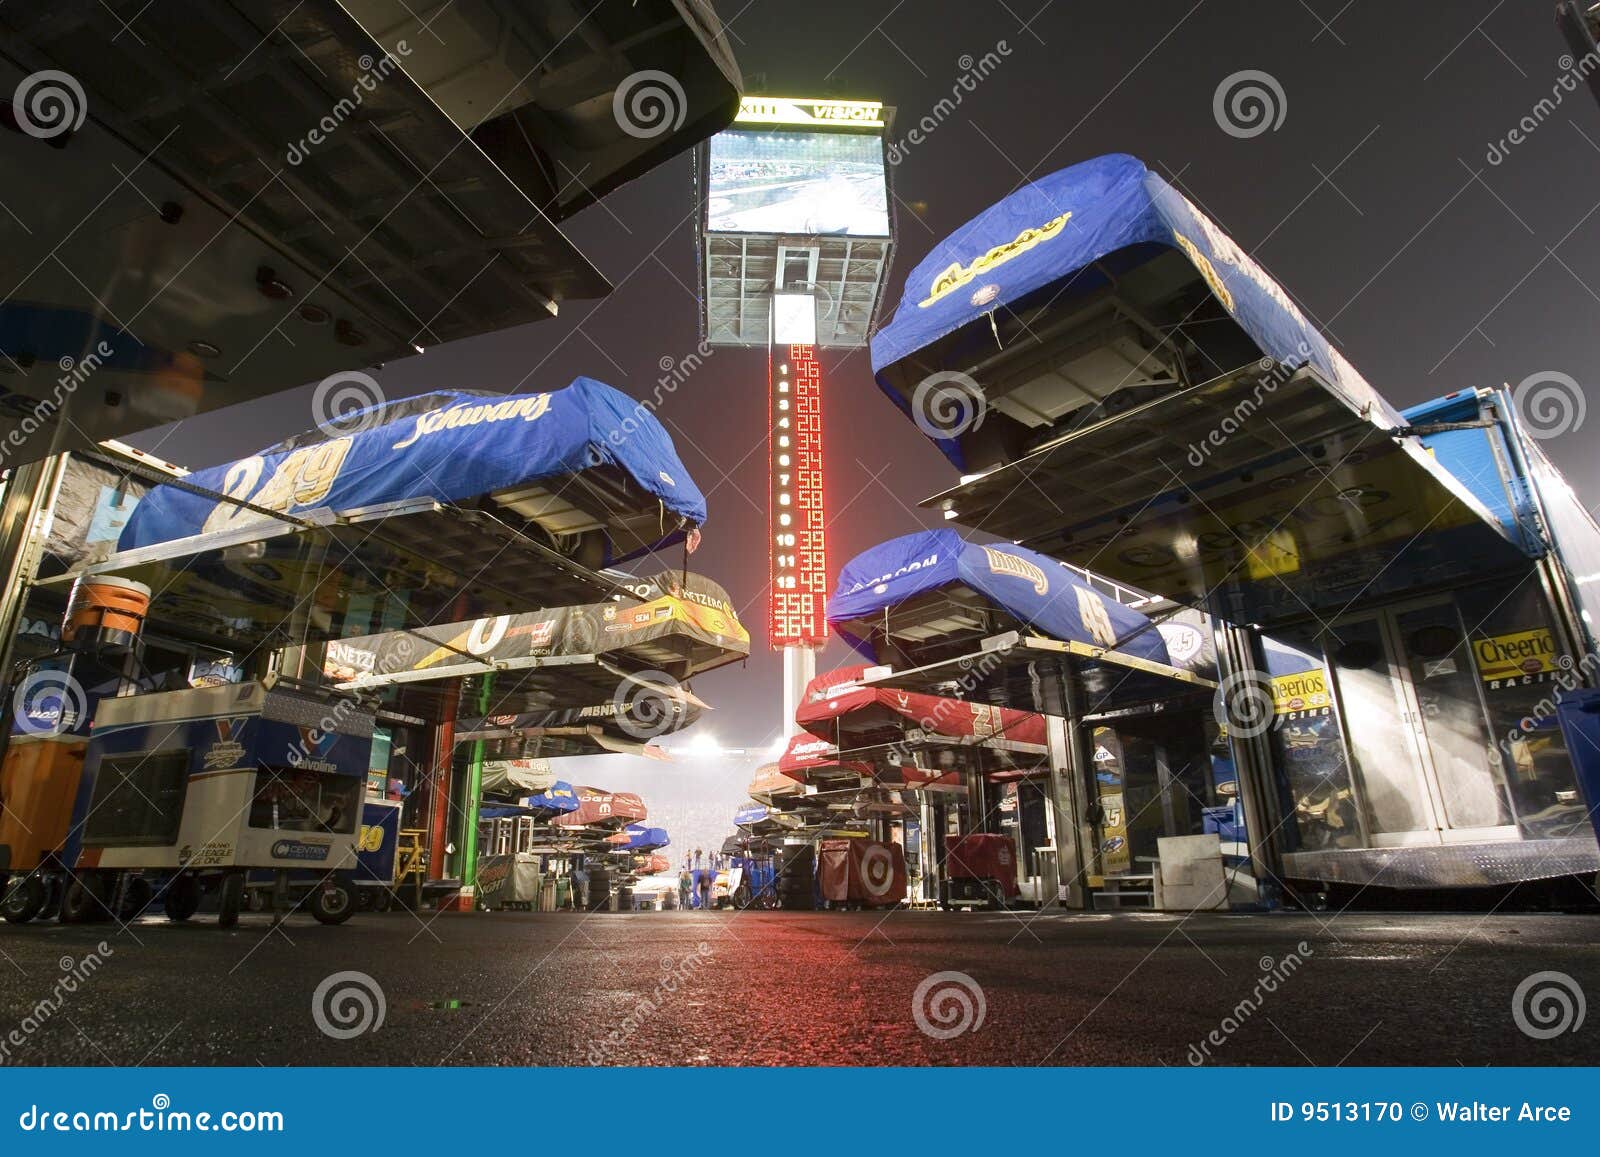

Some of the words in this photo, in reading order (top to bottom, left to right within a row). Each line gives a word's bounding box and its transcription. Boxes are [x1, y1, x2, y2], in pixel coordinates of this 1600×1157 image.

[814, 105, 879, 120] VISION
[779, 364, 788, 375] 1
[796, 361, 819, 377] 46
[797, 378, 820, 395] 64
[778, 399, 789, 410] 3
[797, 396, 820, 413] 20
[778, 417, 789, 428] 4
[797, 414, 821, 431] 20
[798, 433, 821, 450] 34
[798, 452, 822, 469] 34
[779, 474, 790, 486] 7
[798, 471, 822, 489] 58
[799, 490, 823, 508] 58
[807, 510, 824, 529] 19
[776, 534, 795, 546] 10
[799, 531, 825, 549] 39
[777, 555, 795, 567] 11
[800, 551, 825, 571] 39
[776, 576, 796, 588] 12
[800, 572, 826, 592] 49
[774, 594, 814, 614] 358
[774, 616, 814, 636] 364
[1480, 634, 1557, 664] Cheerio
[579, 706, 618, 718] MBNA
